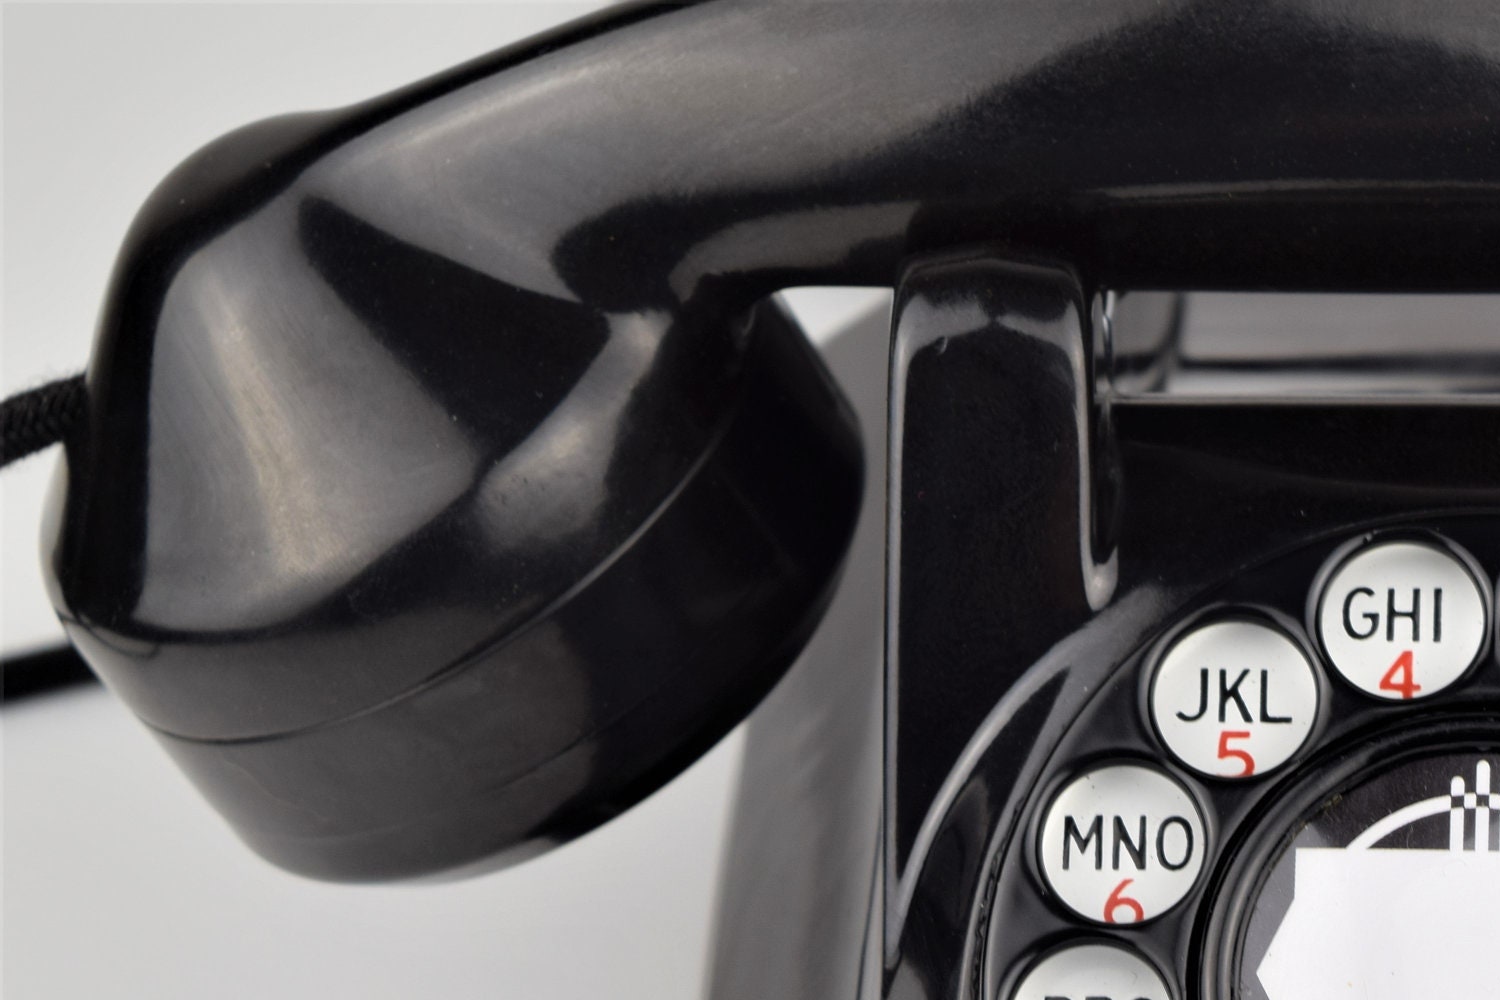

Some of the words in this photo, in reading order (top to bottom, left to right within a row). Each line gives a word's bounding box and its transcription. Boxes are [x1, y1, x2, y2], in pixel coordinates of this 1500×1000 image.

[1342, 587, 1443, 642] GHI
[1176, 668, 1293, 724] JKL
[1379, 650, 1421, 700] 4
[1217, 731, 1255, 778] 5
[1062, 815, 1194, 872] MNO
[1103, 879, 1144, 924] 6
